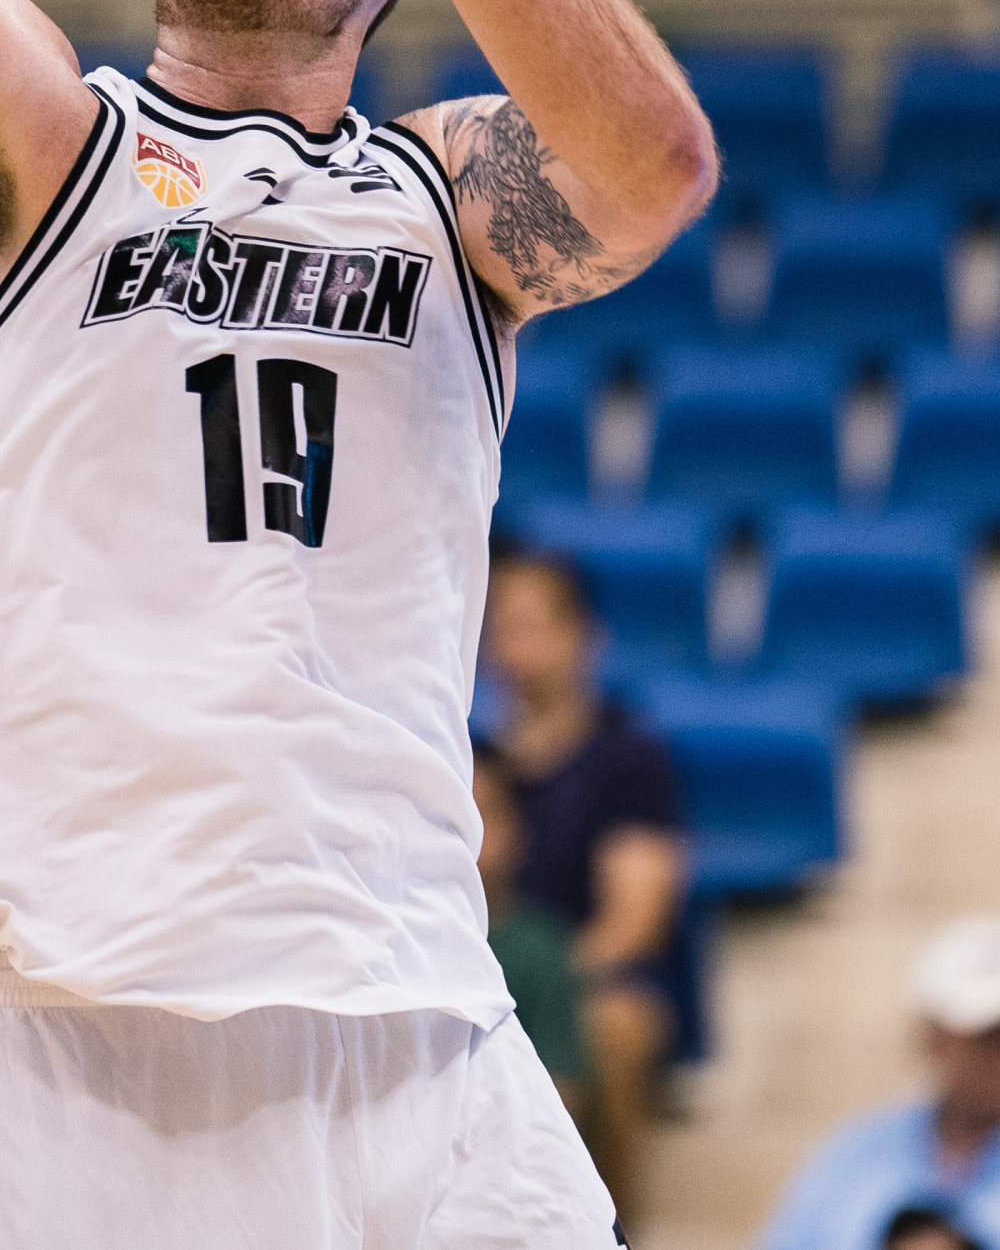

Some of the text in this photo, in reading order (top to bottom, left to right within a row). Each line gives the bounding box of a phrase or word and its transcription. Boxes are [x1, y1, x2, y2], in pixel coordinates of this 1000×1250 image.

[140, 138, 200, 179] ABL
[83, 218, 432, 347] EASTERN
[185, 354, 338, 548] 19
